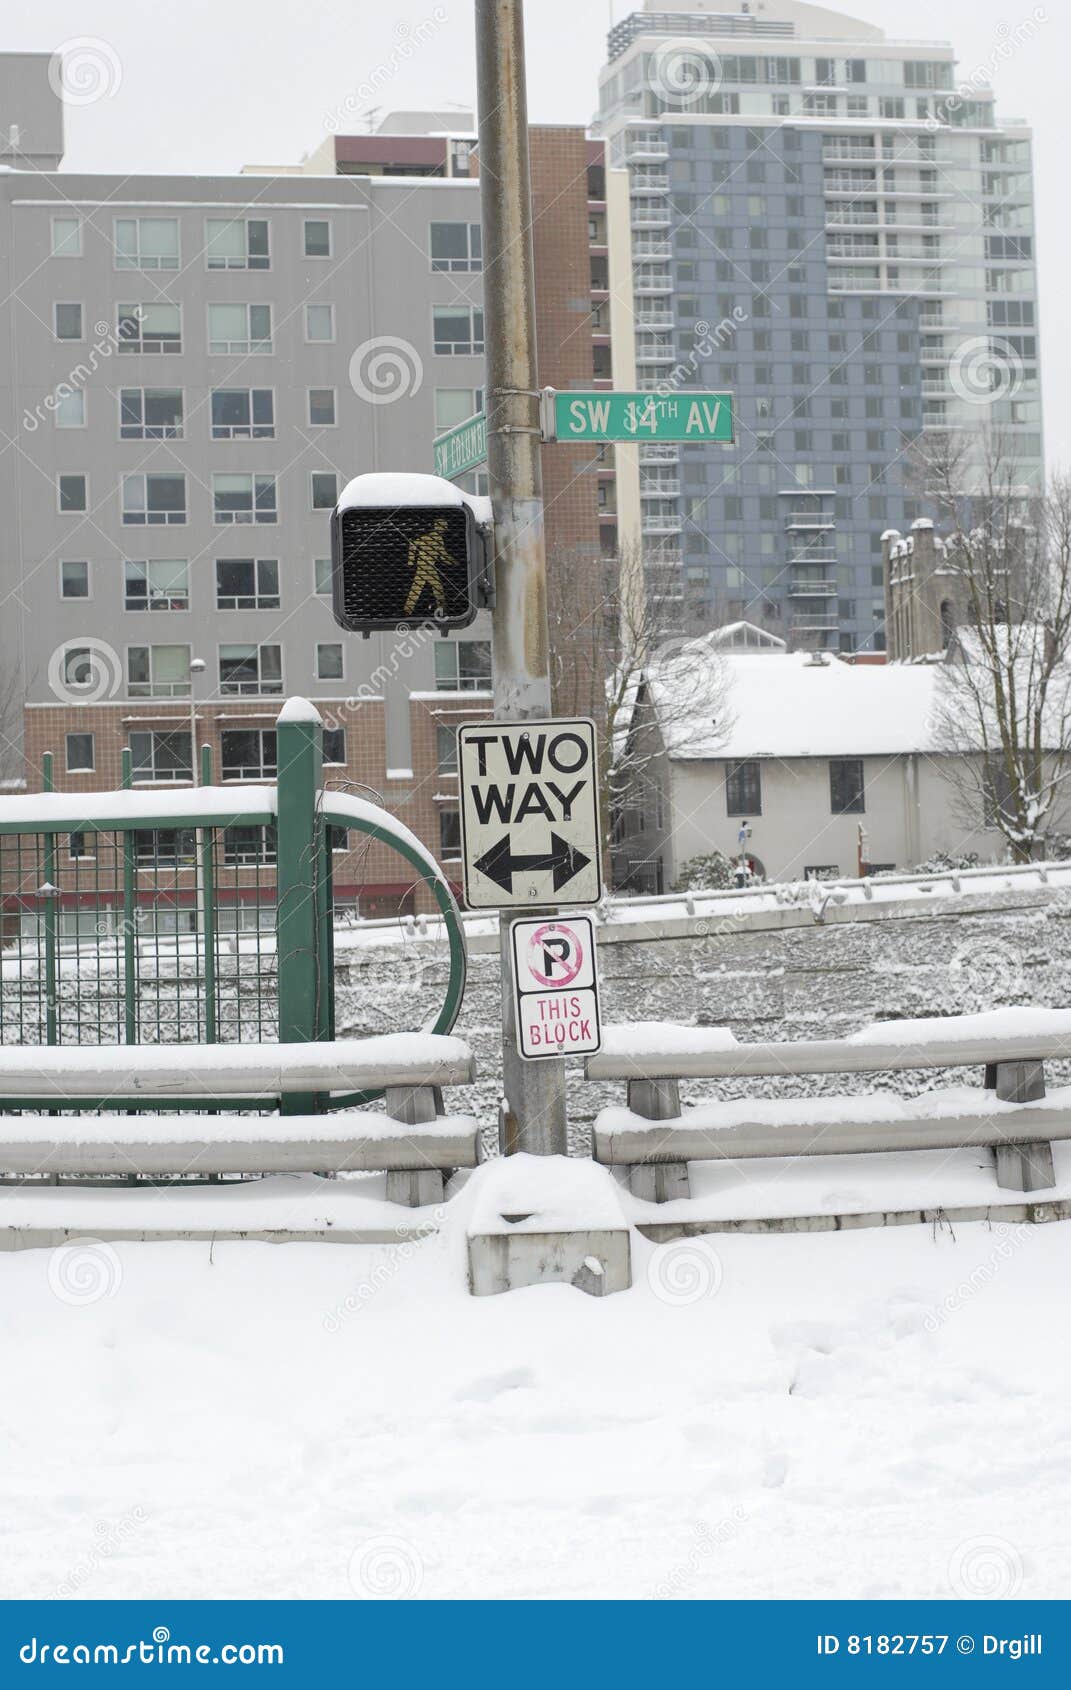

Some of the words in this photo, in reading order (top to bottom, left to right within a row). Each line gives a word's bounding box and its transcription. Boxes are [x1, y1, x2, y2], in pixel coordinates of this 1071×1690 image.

[569, 400, 611, 433] SW
[685, 400, 721, 434] AV
[436, 443, 448, 476] SW
[465, 732, 588, 776] TWO
[470, 780, 587, 825] WAY
[537, 996, 581, 1020] THIS
[530, 1019, 592, 1045] BLOCK
